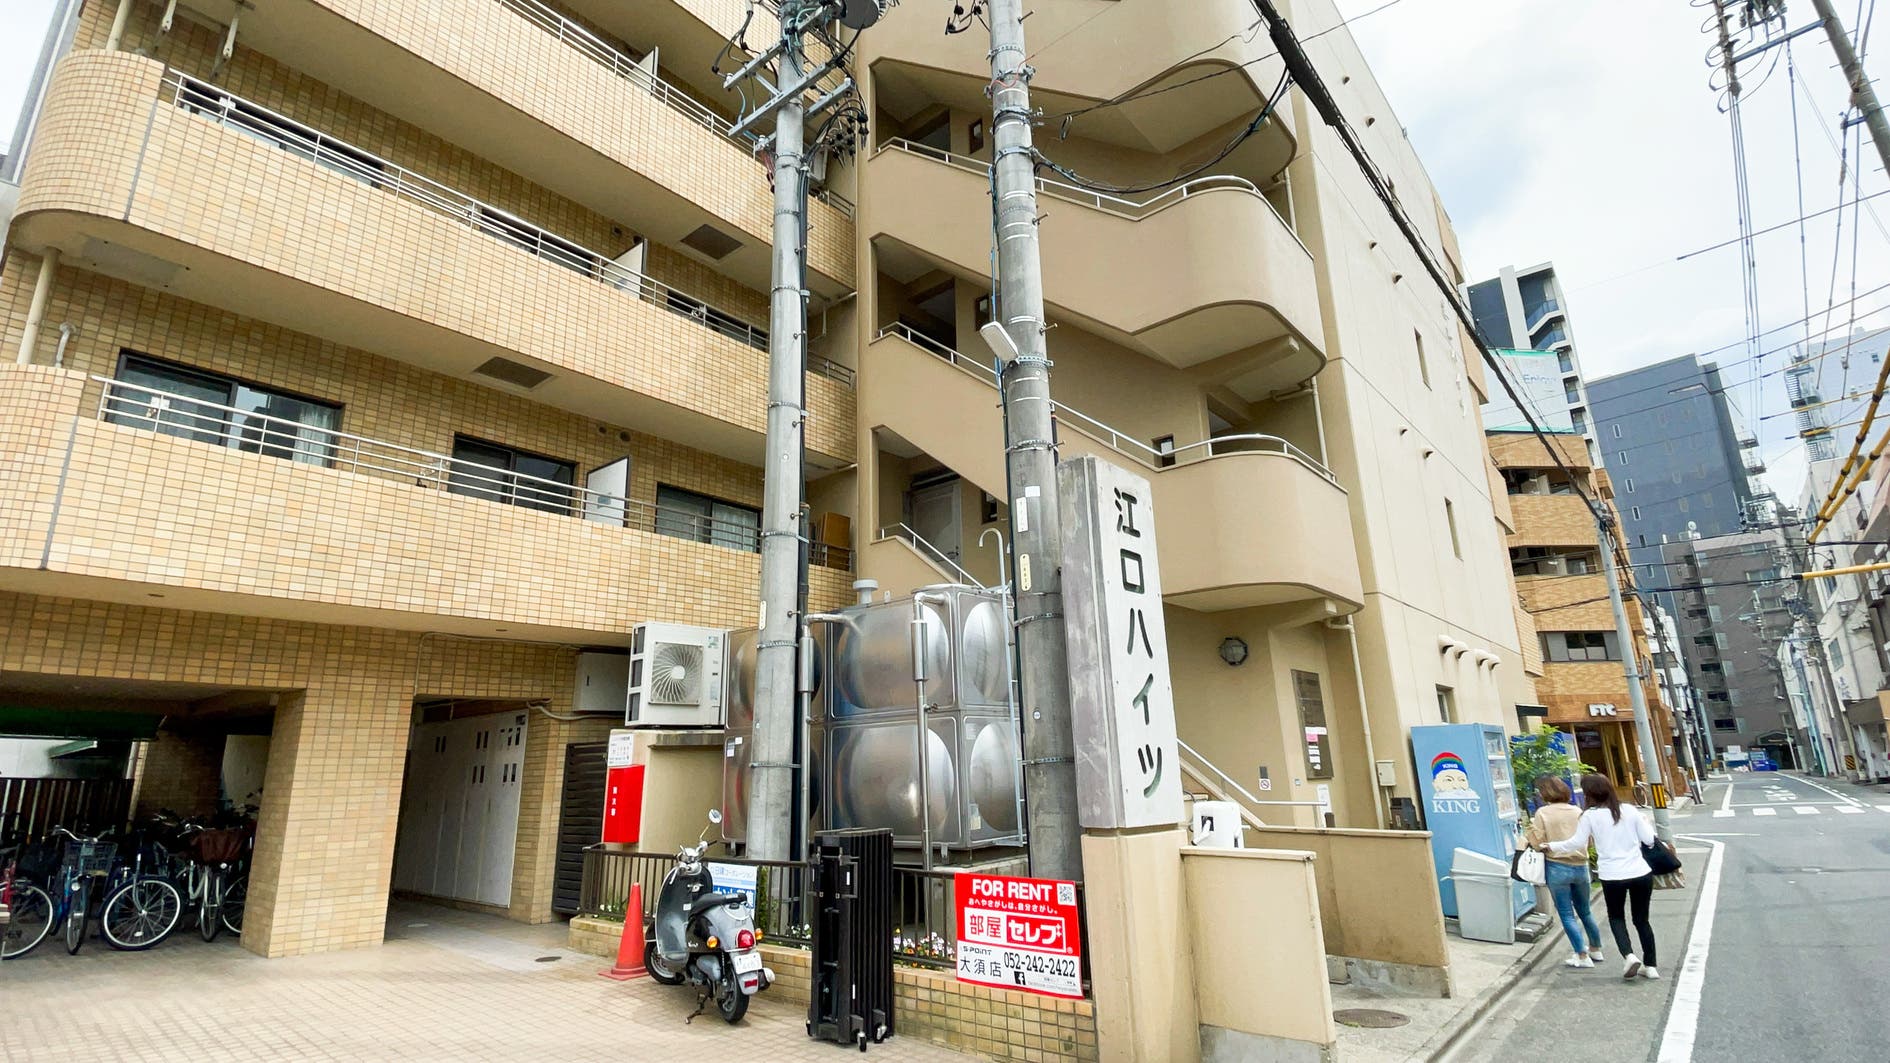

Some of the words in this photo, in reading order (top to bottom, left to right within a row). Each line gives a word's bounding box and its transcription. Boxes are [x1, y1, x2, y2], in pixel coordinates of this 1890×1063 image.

[1588, 703, 1617, 717] FTC
[1432, 799, 1480, 814] KING
[972, 878, 1004, 897] FOR
[1007, 881, 1053, 902] RENT
[960, 956, 1002, 978] 大須店
[1004, 951, 1076, 978] 052-242-2422
